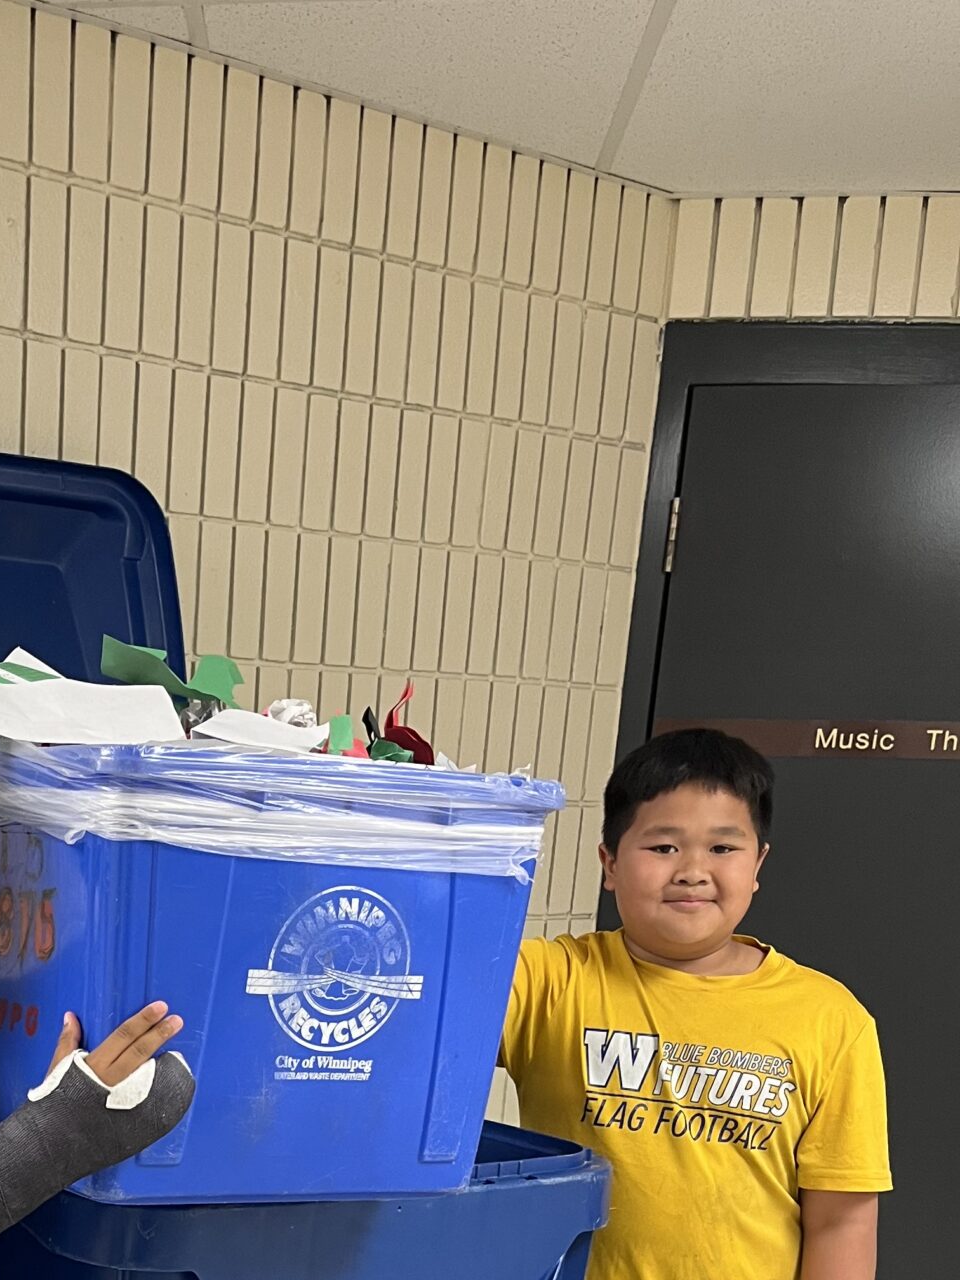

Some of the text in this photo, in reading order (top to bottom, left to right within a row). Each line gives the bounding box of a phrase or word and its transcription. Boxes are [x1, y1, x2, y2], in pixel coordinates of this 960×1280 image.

[814, 727, 958, 751] Music Th
[278, 993, 388, 1045] RECYCLES
[275, 1055, 373, 1073] City of Winnipeg
[583, 1027, 660, 1092] W
[661, 1041, 792, 1078] BLUE BOMBERS
[652, 1060, 797, 1118] FUTURES
[581, 1096, 777, 1151] FLAG FOOTBALL
